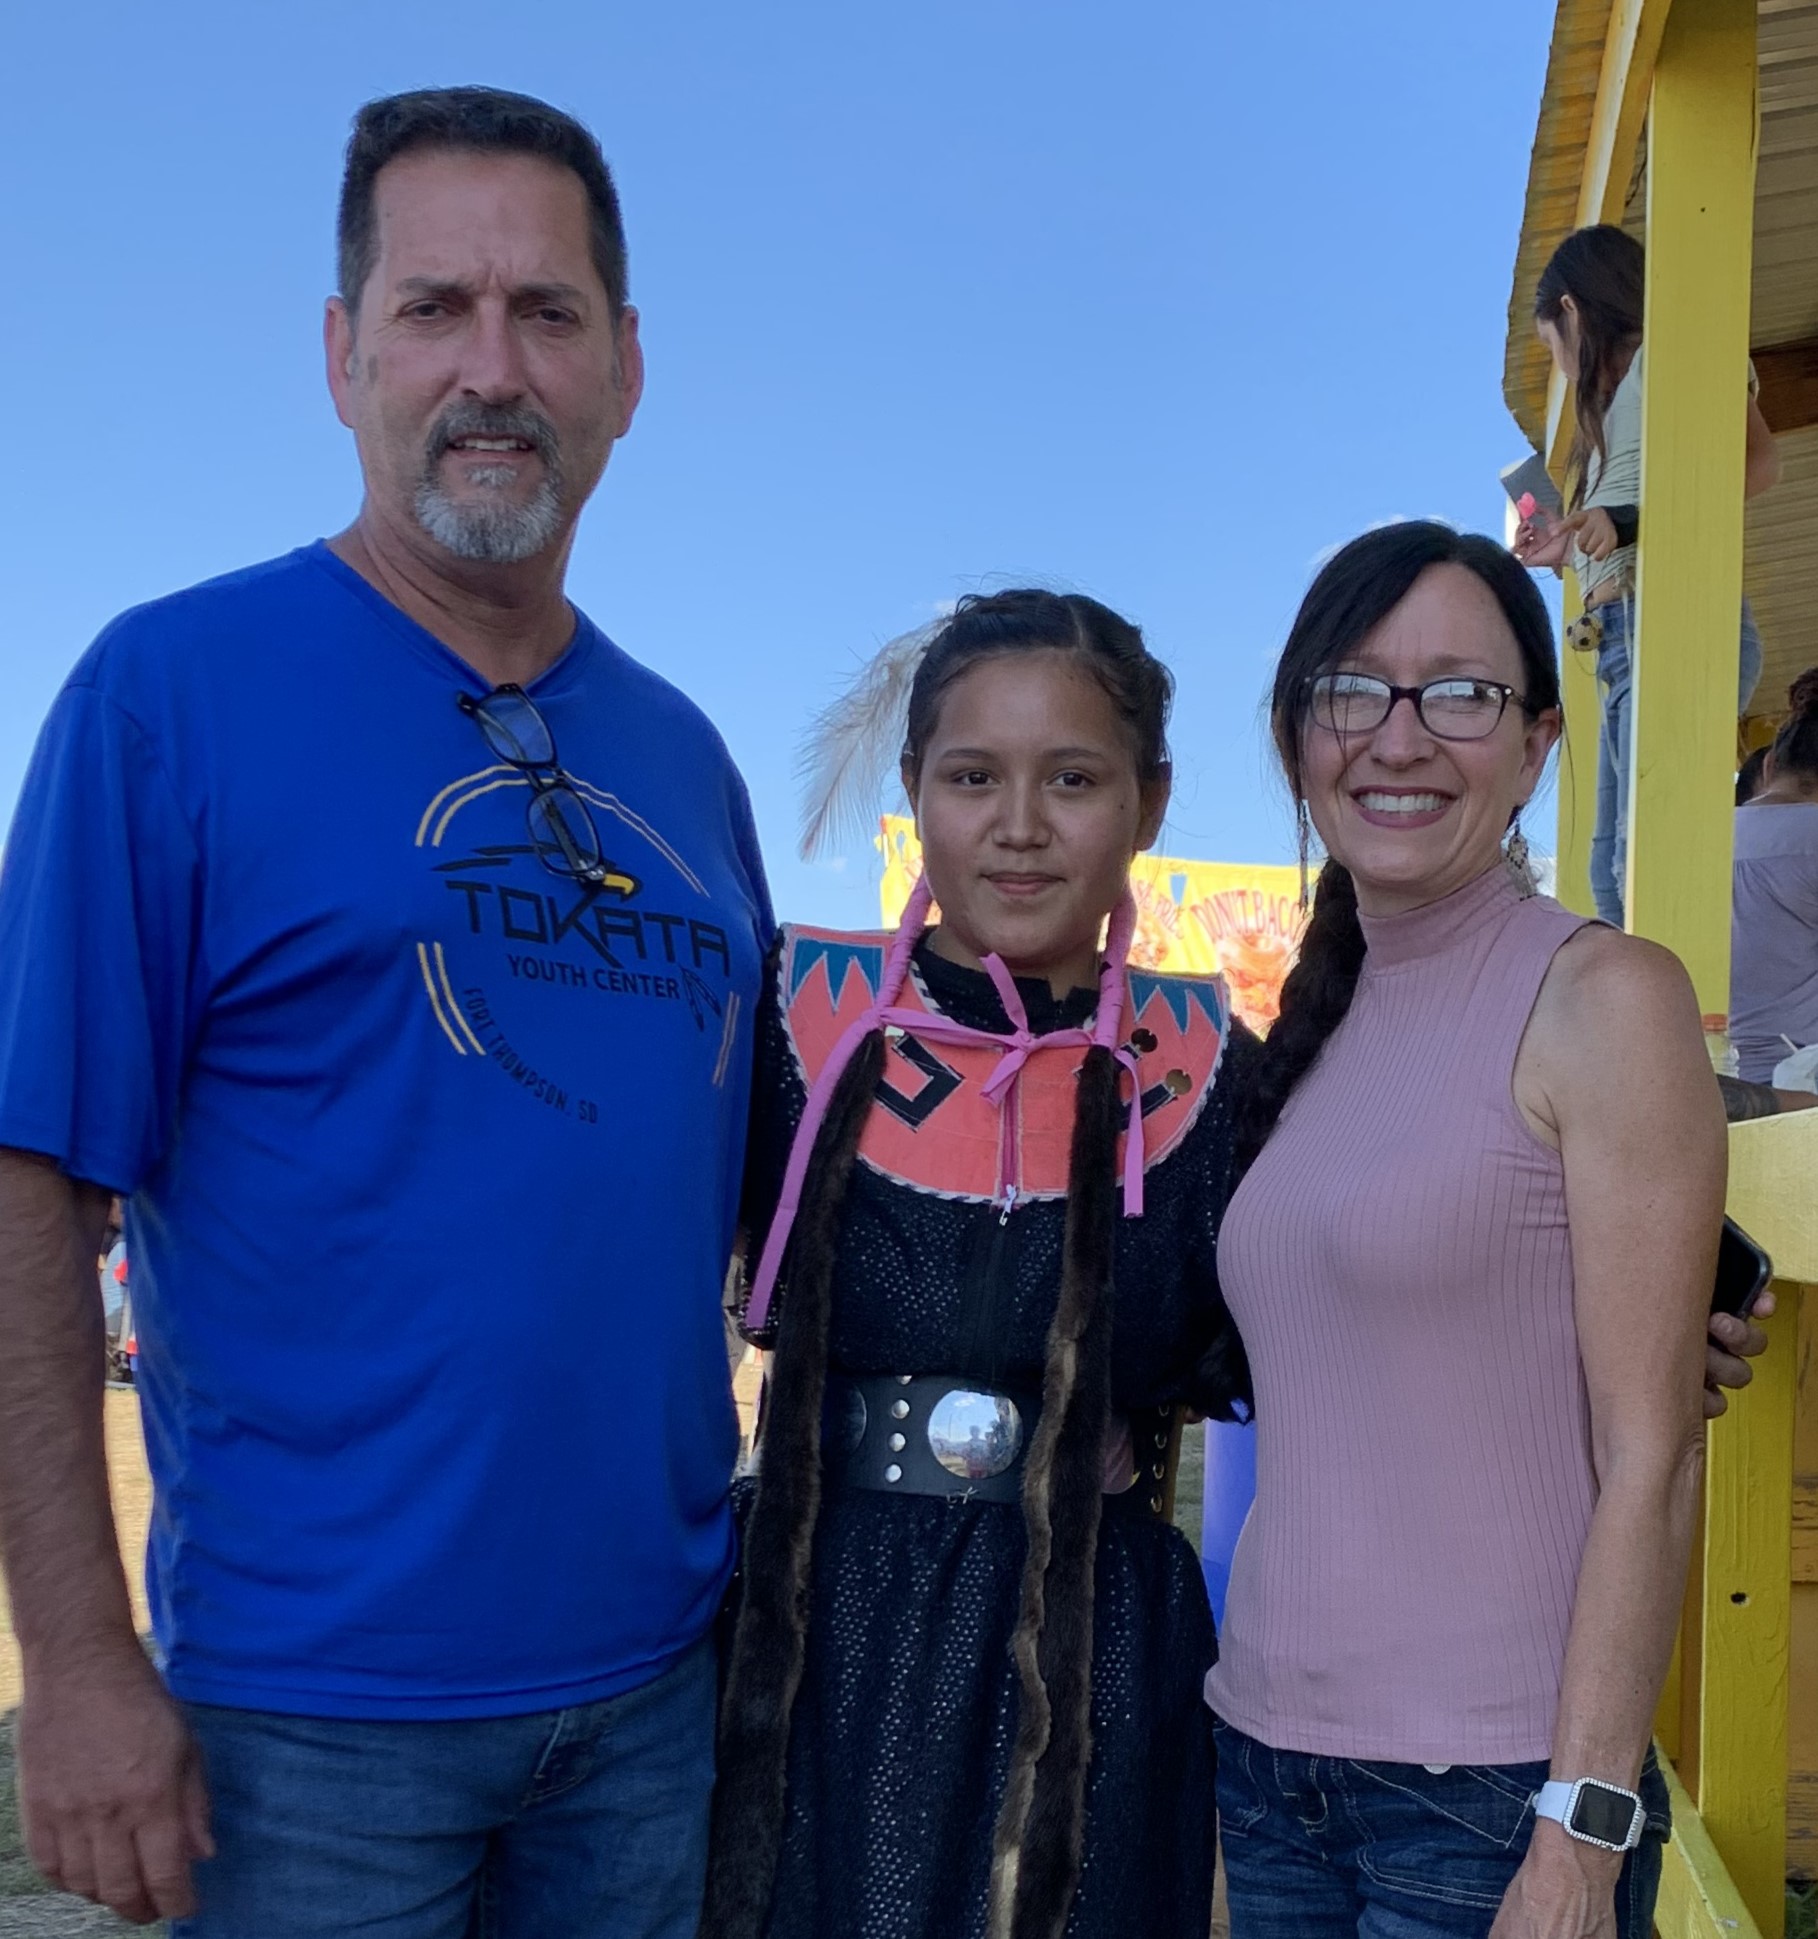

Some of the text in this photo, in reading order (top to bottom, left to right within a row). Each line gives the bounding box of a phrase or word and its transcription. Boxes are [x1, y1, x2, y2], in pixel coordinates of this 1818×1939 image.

[445, 880, 730, 978] TOKATA
[507, 953, 680, 1000] YOUTH CENTER
[463, 987, 495, 1032] FORT
[579, 1100, 598, 1124] SD
